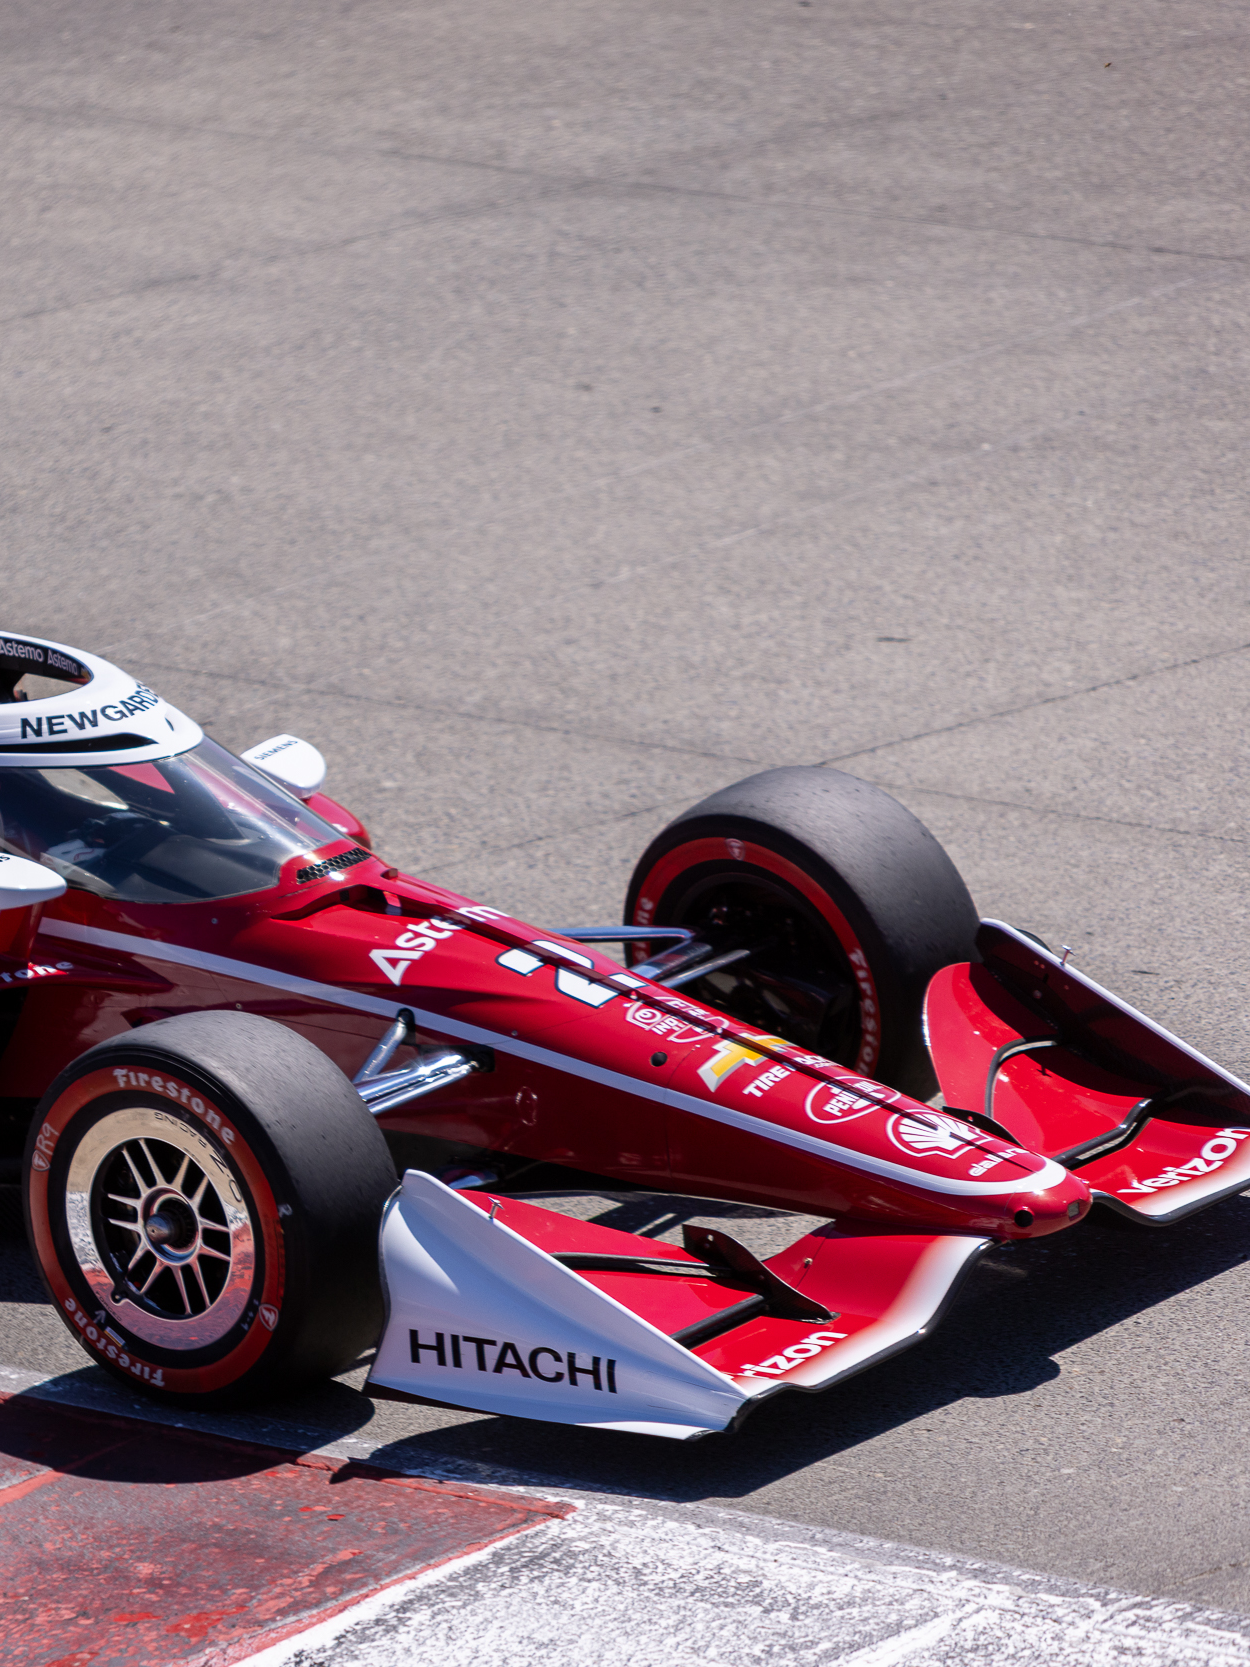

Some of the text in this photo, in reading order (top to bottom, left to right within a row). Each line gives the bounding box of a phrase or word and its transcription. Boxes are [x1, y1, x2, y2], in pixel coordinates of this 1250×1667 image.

[47, 650, 79, 676] Astemo
[254, 740, 299, 760] SIEMENS
[742, 1065, 791, 1098] TIRE
[112, 1068, 236, 1145] Firestone
[36, 1122, 60, 1155] R9
[1116, 1128, 1250, 1193] verizon
[64, 1297, 165, 1387] Firestone
[409, 1328, 618, 1394] HITACHI
[733, 1331, 848, 1380] rizon
